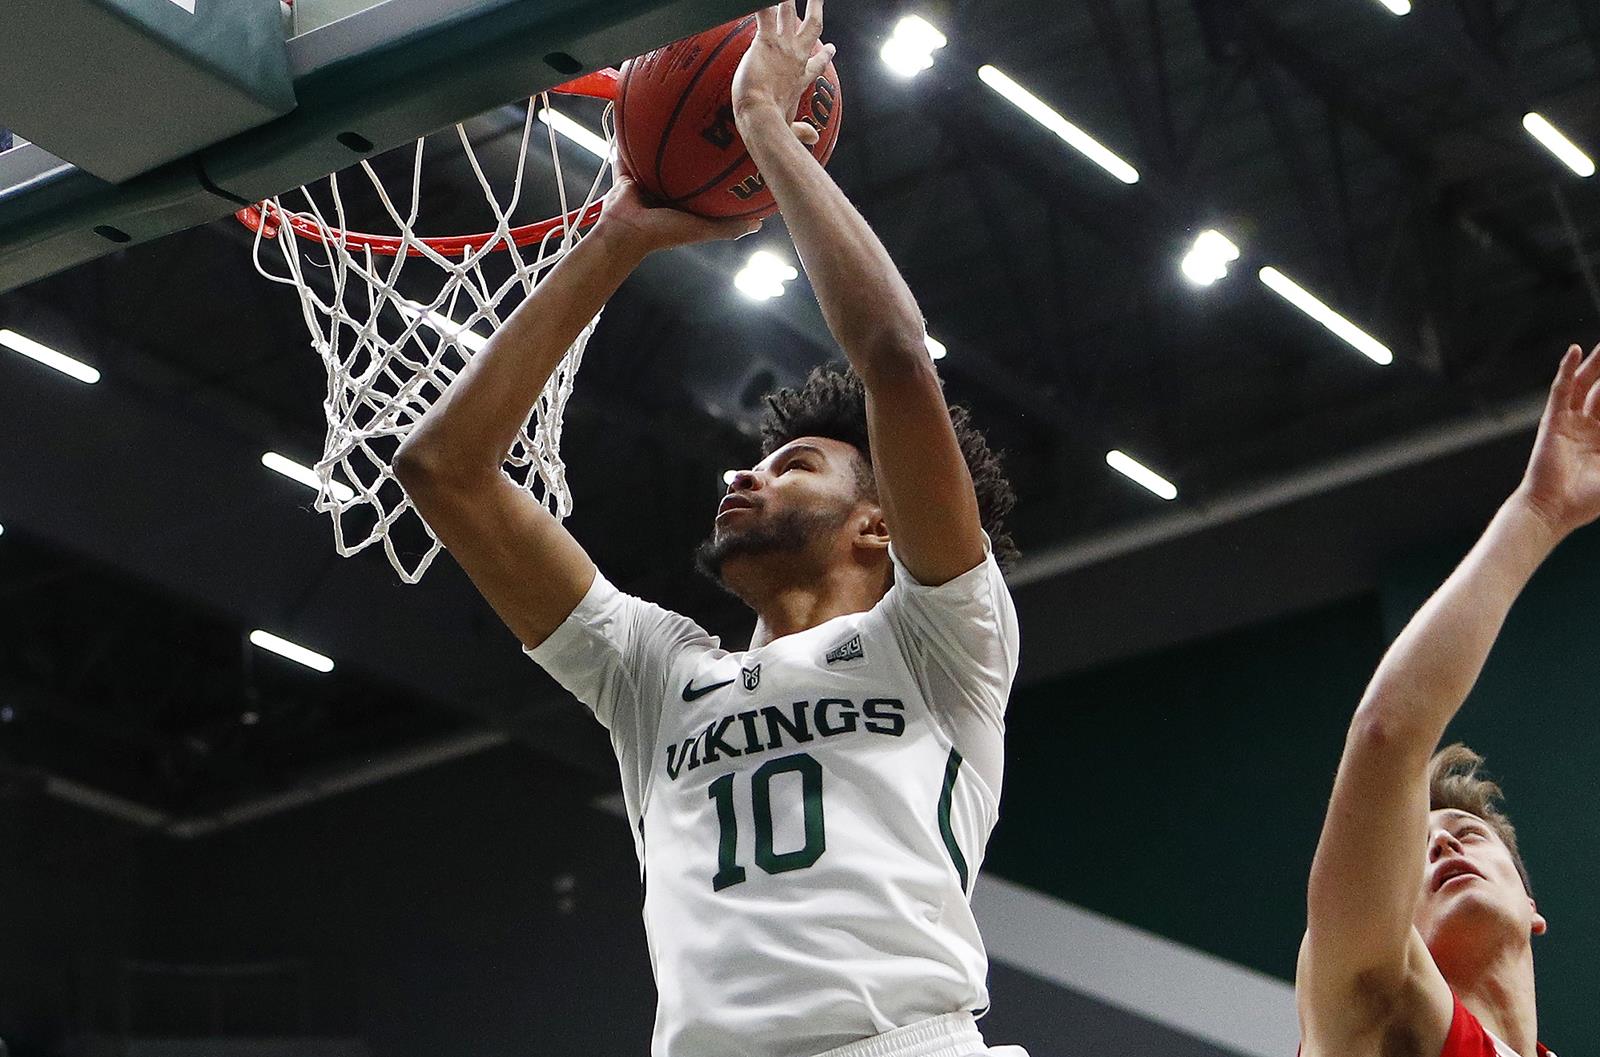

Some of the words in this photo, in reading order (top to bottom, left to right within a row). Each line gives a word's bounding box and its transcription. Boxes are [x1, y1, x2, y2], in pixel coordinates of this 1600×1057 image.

[841, 636, 861, 657] SKY
[666, 698, 906, 781] VIKINGS
[708, 753, 826, 892] 10
